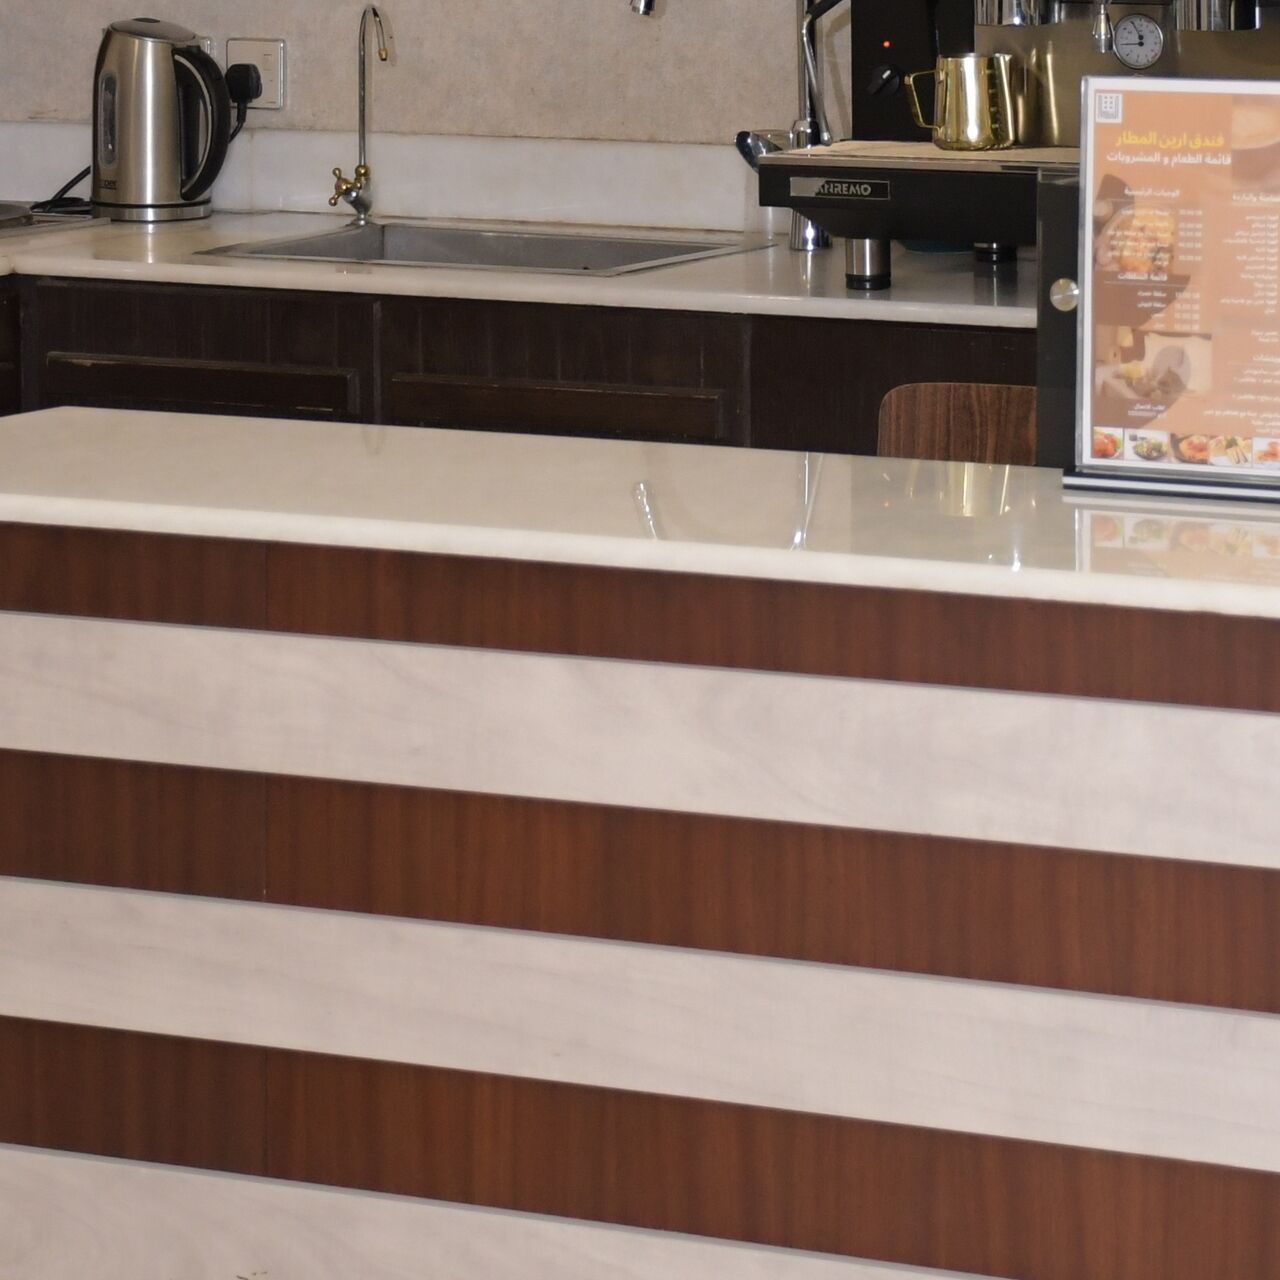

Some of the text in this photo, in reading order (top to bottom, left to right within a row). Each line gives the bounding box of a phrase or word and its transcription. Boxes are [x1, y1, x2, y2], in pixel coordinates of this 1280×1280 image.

[1115, 130, 1158, 148] المطار
[1190, 132, 1225, 150] فندق
[1106, 151, 1161, 165] المشروبات
[1170, 153, 1202, 168] الطعام
[1204, 152, 1233, 165] قائمة
